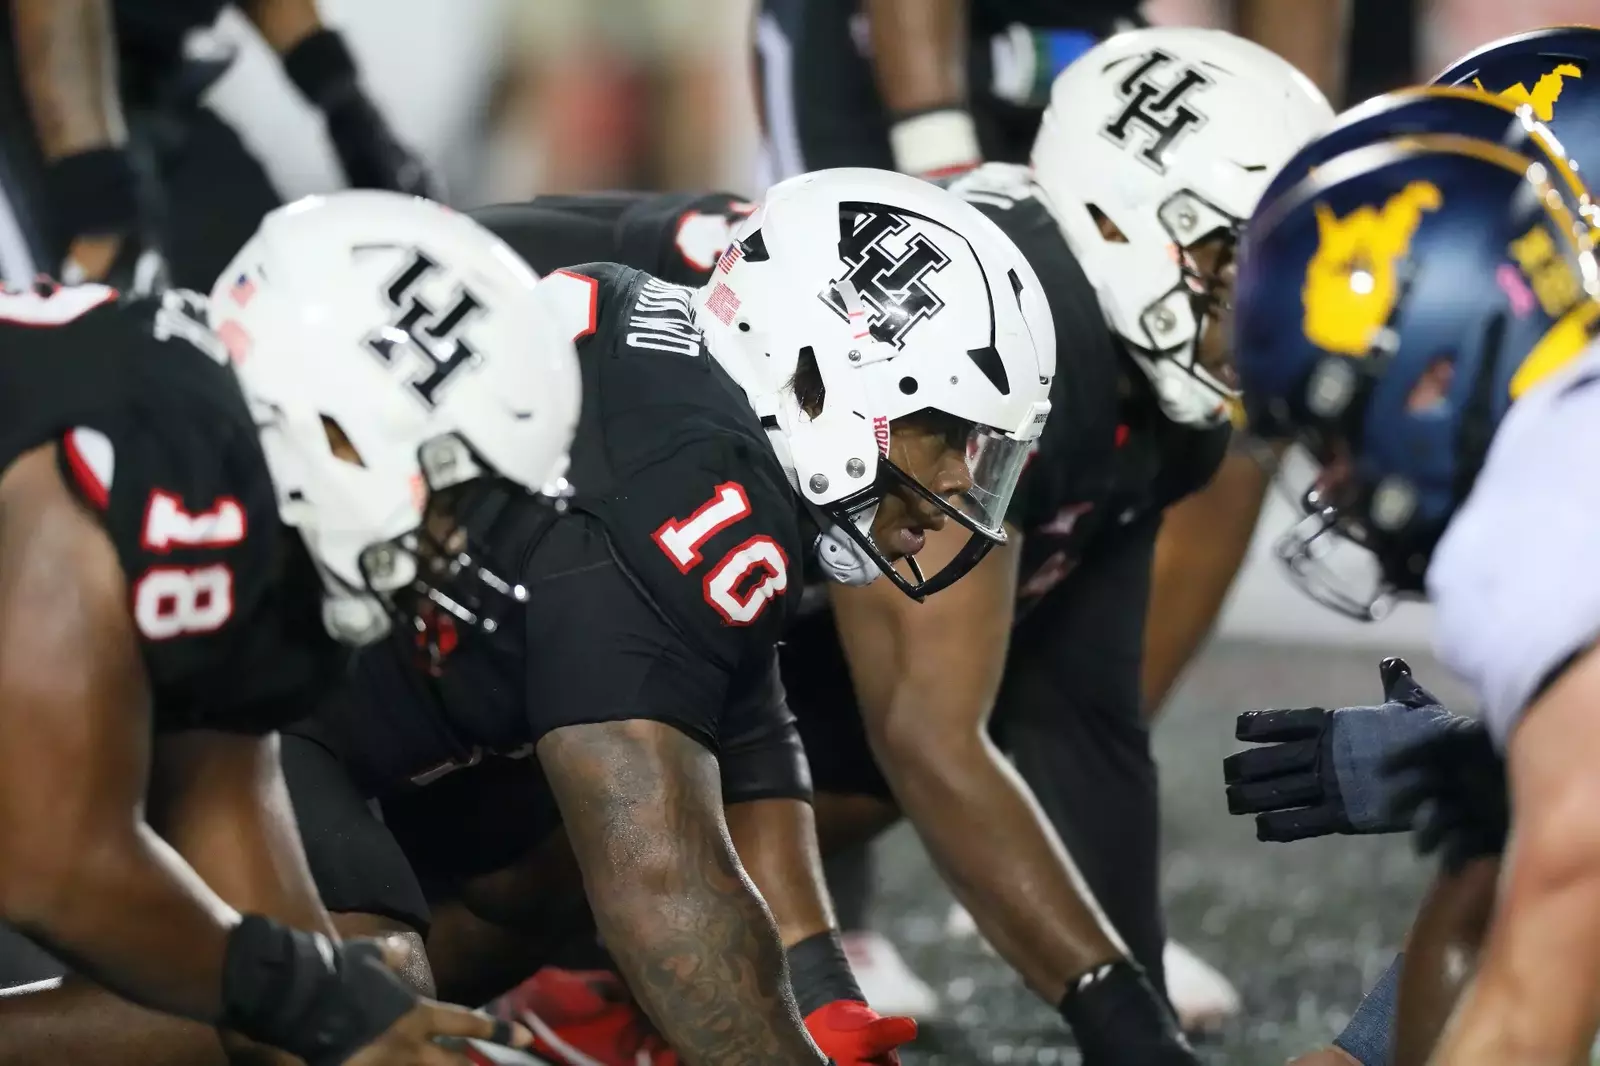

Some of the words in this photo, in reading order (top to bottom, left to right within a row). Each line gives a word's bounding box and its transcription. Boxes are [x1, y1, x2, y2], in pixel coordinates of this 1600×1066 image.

[873, 416, 888, 458] HOU
[133, 487, 249, 642] 18
[650, 480, 790, 627] 10
